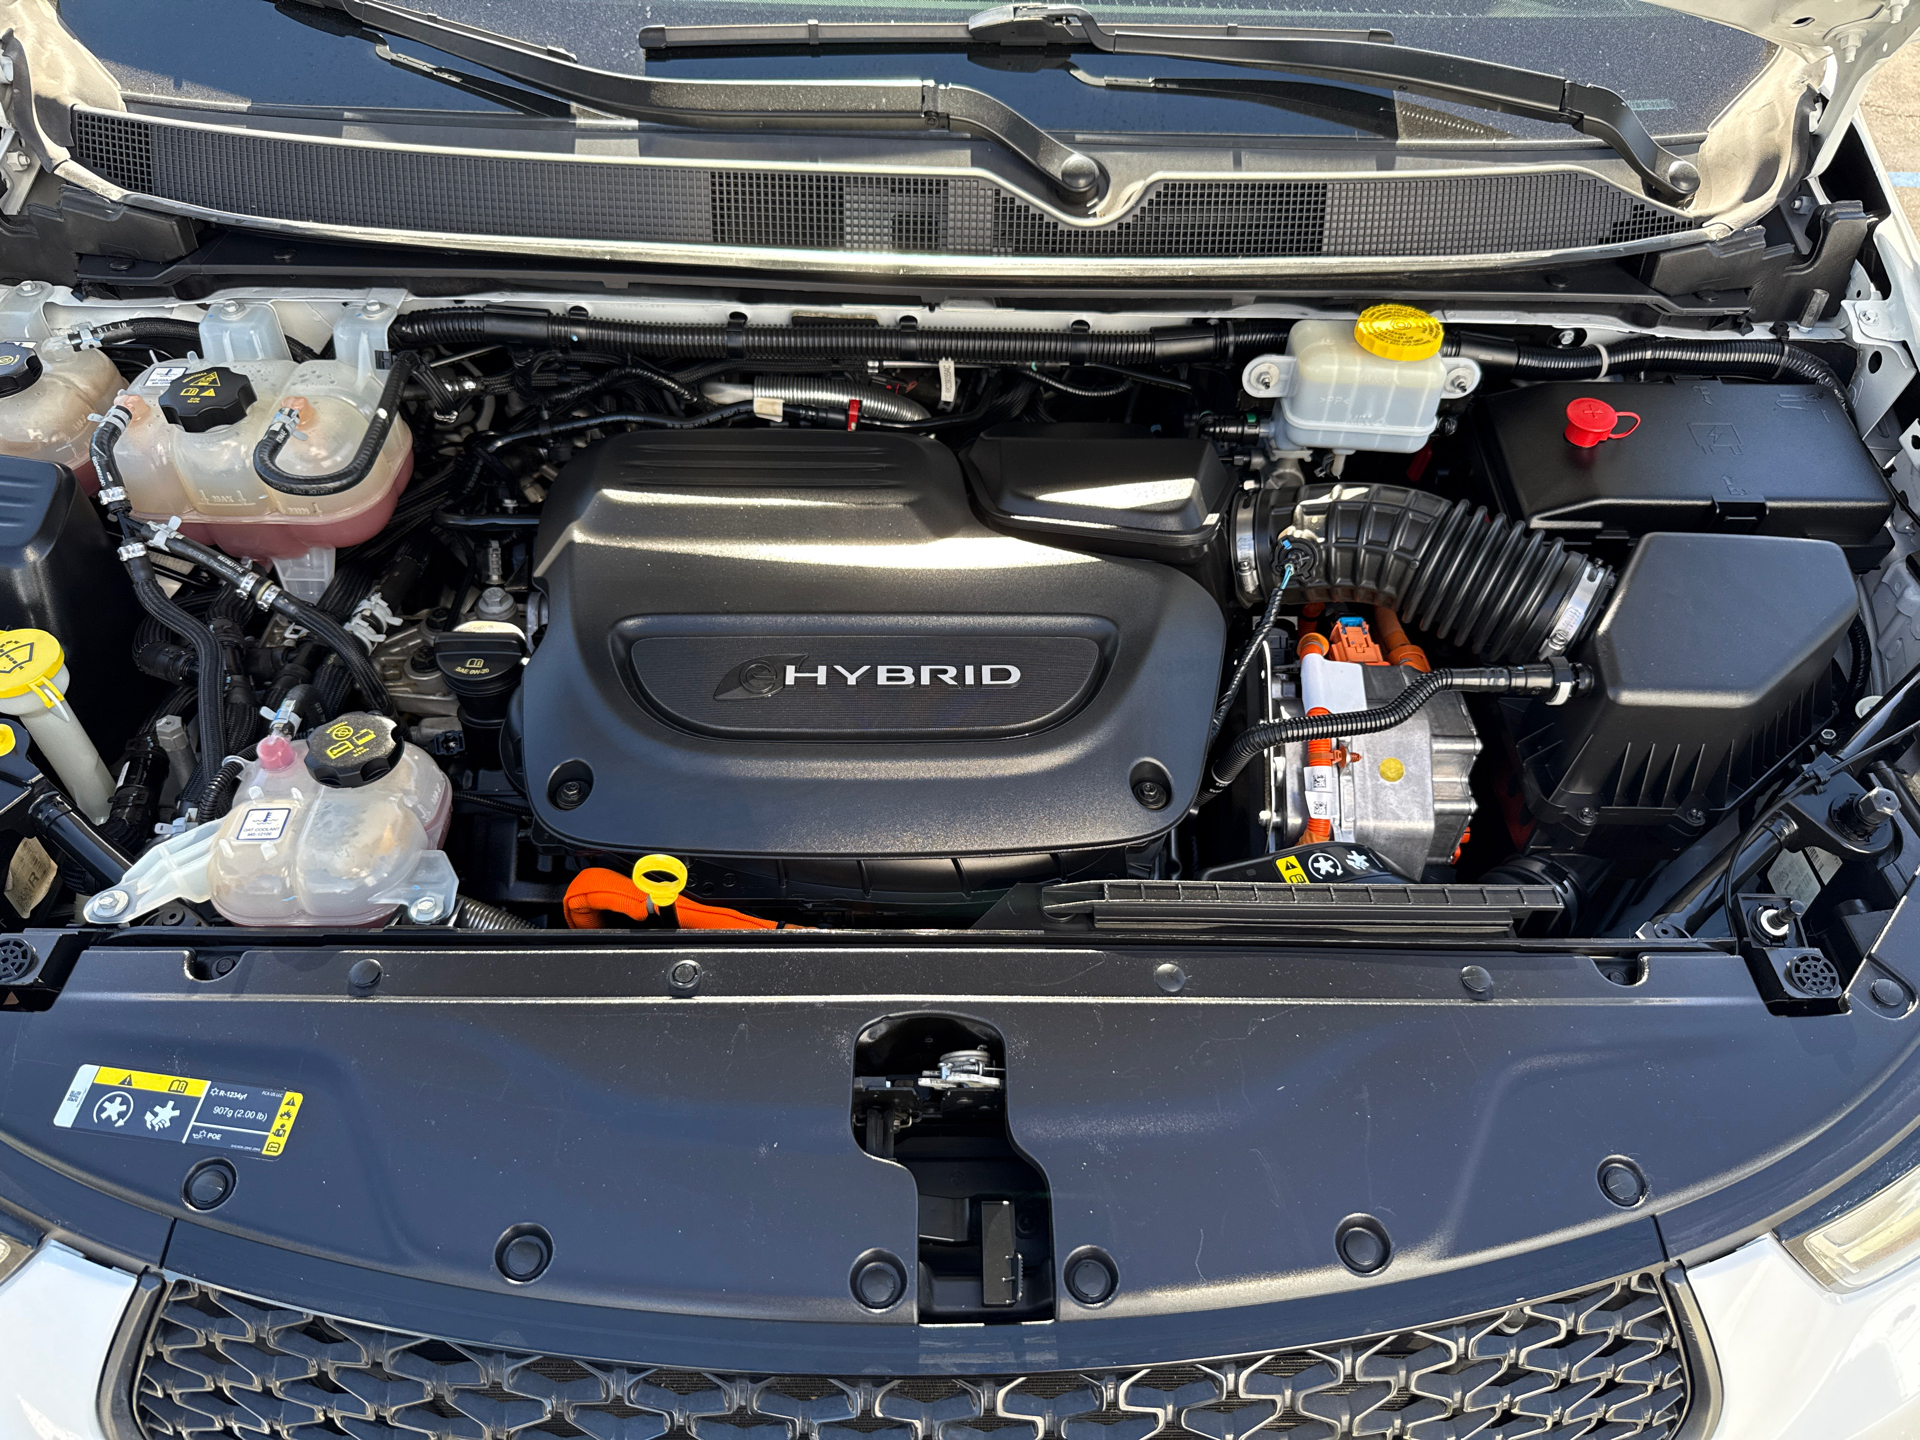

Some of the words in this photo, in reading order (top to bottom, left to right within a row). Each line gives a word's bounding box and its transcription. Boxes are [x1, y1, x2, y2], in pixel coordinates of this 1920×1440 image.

[455, 666, 469, 674] SAE
[784, 665, 1021, 687] HYBRID
[213, 1105, 233, 1118] 907g
[234, 1109, 256, 1120] (2.00
[256, 1111, 268, 1122] lb)
[207, 1132, 222, 1140] POE
